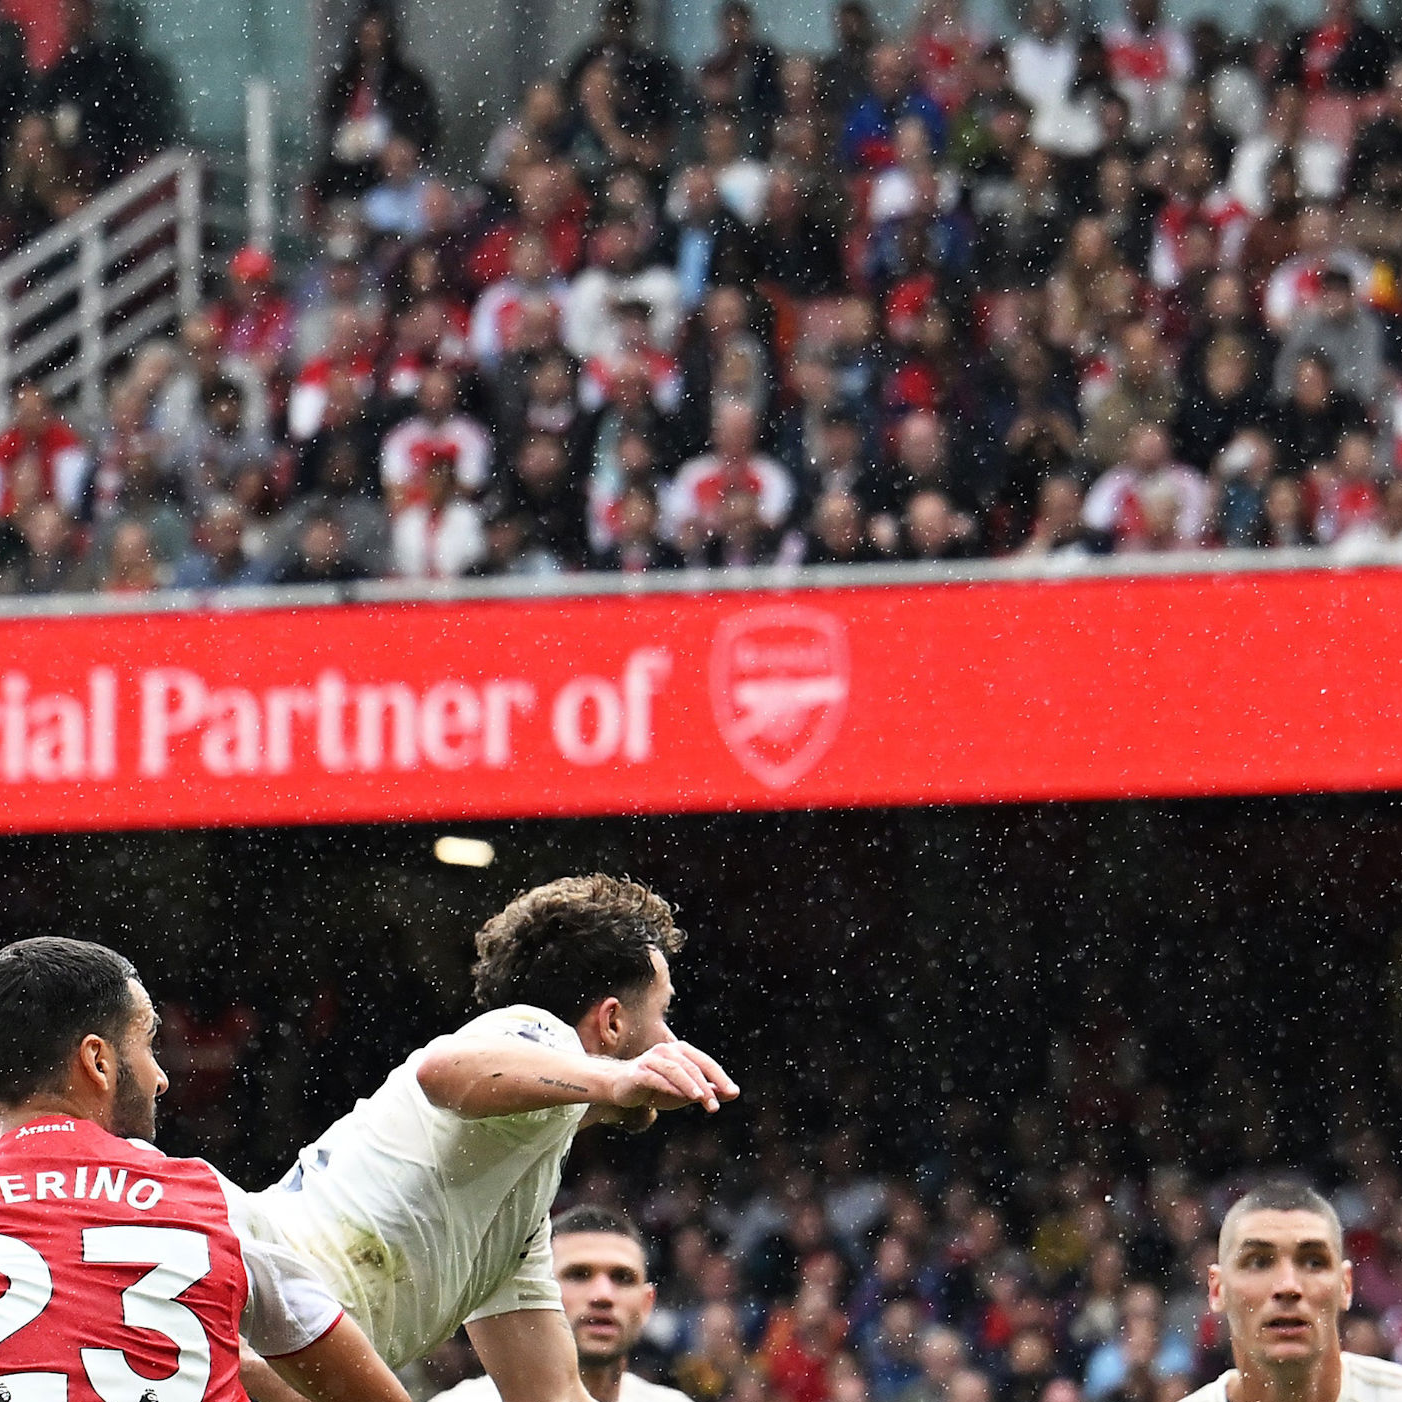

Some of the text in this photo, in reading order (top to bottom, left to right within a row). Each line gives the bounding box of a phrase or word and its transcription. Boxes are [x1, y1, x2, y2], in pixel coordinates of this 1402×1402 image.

[139, 667, 536, 776] Partner
[551, 646, 673, 763] of
[15, 1120, 76, 1139] Arsenal
